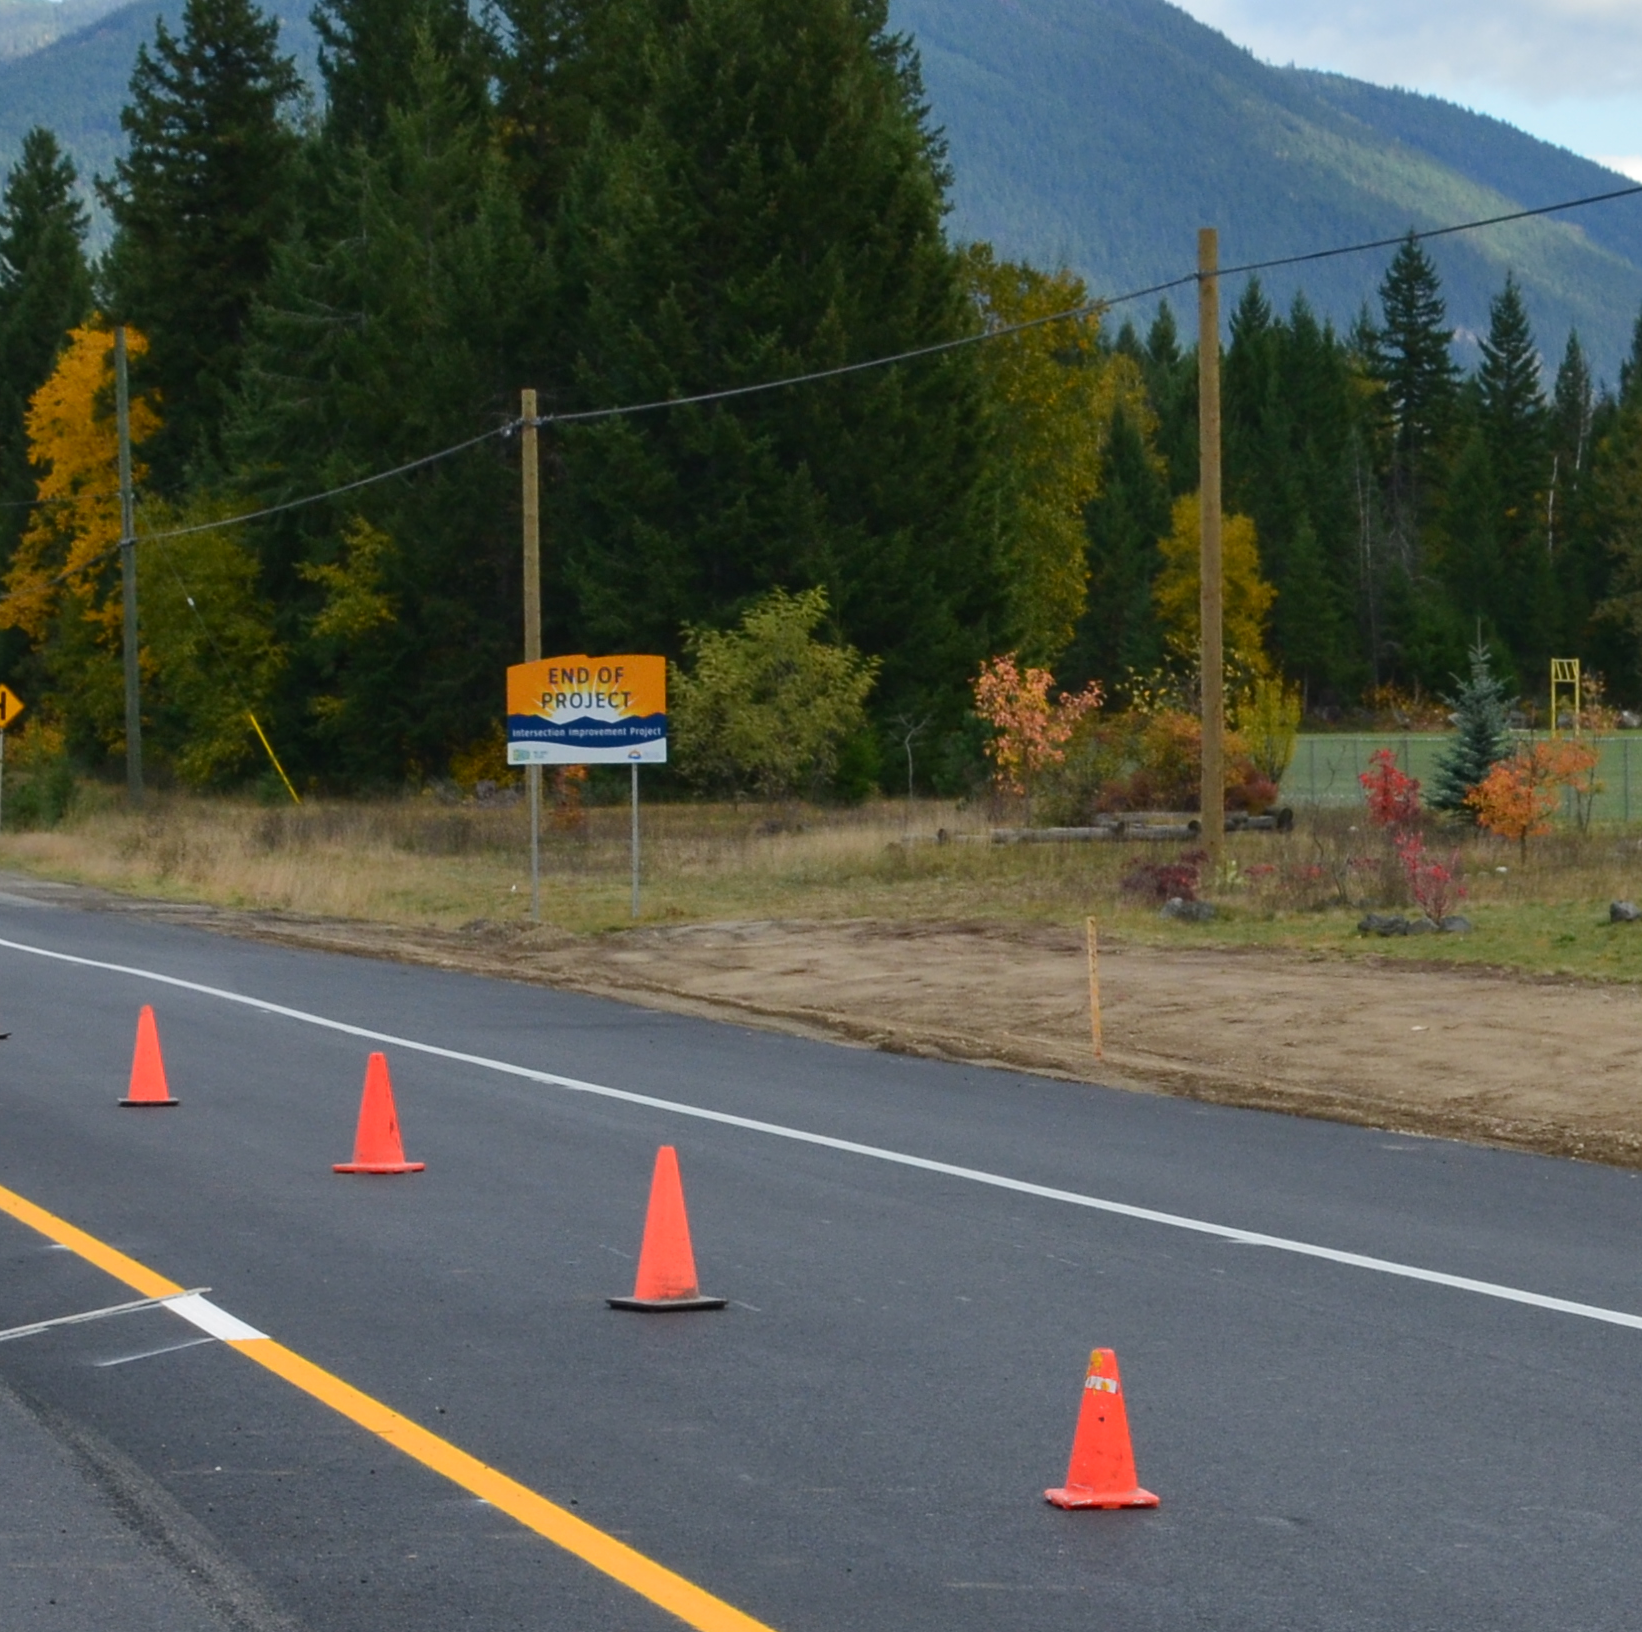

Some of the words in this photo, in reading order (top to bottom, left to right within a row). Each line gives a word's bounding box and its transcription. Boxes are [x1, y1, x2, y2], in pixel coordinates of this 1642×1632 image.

[549, 668, 589, 684] END
[598, 667, 624, 684] OF
[542, 692, 631, 708] PROJECT
[512, 728, 565, 737] Intersection
[569, 727, 626, 738] Improvement
[630, 727, 661, 737] Project
